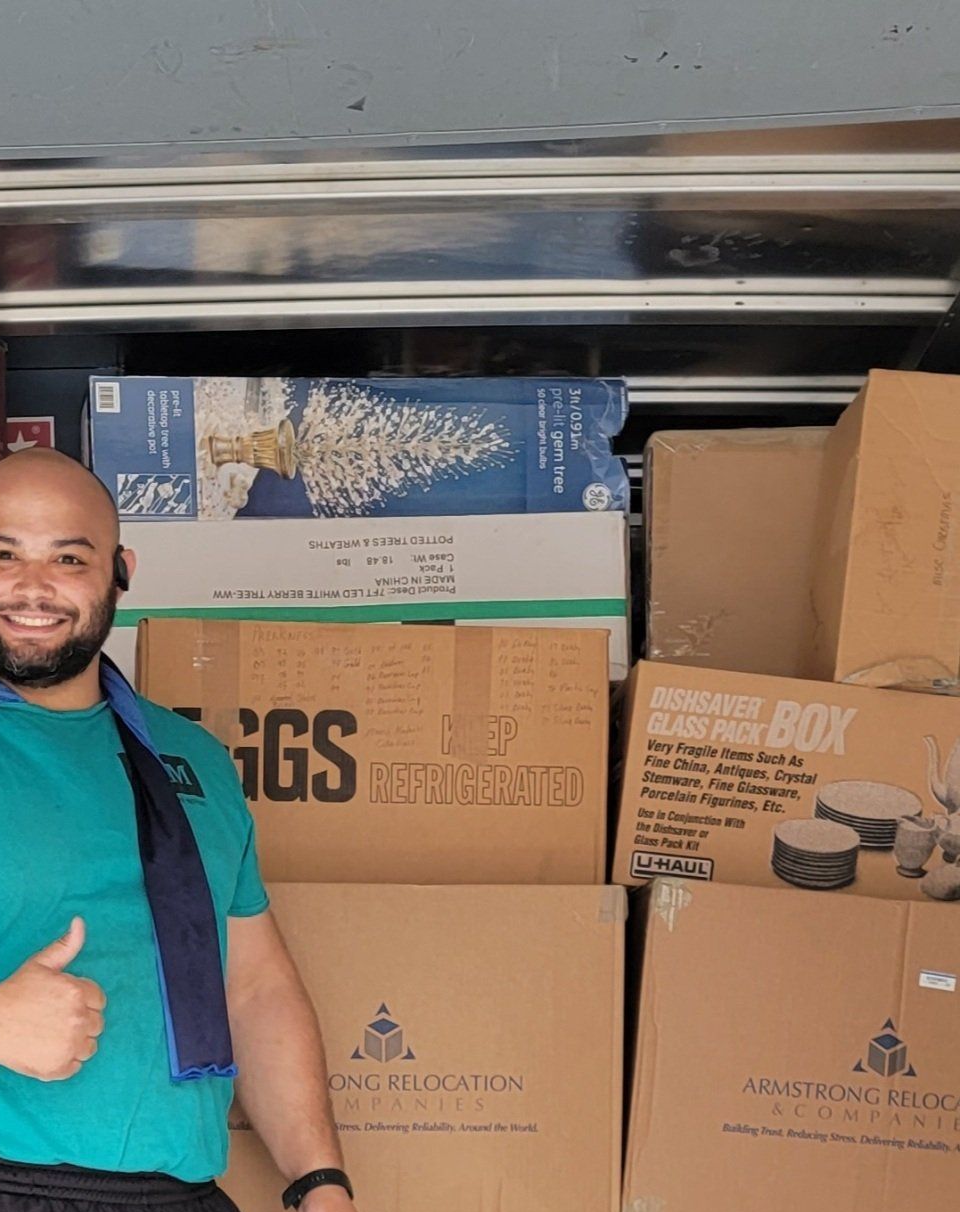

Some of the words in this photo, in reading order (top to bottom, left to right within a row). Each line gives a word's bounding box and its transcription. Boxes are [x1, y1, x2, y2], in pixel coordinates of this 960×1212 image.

[537, 388, 546, 398] 50
[159, 390, 169, 428] tabletop
[171, 390, 182, 417] pre-lit
[538, 399, 546, 418] clear
[549, 388, 567, 428] pre-lit
[147, 390, 157, 438] decorative
[160, 429, 170, 448] tree
[537, 421, 547, 445] bright
[147, 439, 157, 455] pot
[550, 430, 564, 462] gem
[162, 450, 171, 468] with
[539, 446, 547, 470] bulbs
[553, 466, 566, 494] tree
[308, 539, 361, 549] WREATHS
[363, 539, 371, 548] &
[372, 537, 408, 547] TREES
[410, 536, 453, 545] POTTED
[336, 558, 351, 567] lbs
[366, 556, 393, 566] 18.48
[428, 553, 454, 562] Case
[419, 564, 444, 573] Pack
[375, 576, 409, 586] CHINA
[410, 576, 423, 585] IN
[424, 575, 455, 584] MADE
[212, 589, 265, 600] TREE-WW
[267, 589, 305, 599] BERRY
[306, 589, 340, 599] WHITE
[343, 588, 364, 598] LED
[365, 586, 385, 597] 7FT
[390, 587, 416, 595] Desc:
[417, 586, 456, 595] Product
[649, 686, 762, 719] DISHSAVER
[442, 714, 518, 756] KEP
[646, 712, 709, 740] GLASS
[709, 721, 764, 746] PACK
[766, 700, 858, 755] BOX
[172, 708, 357, 802] GGS
[646, 740, 674, 756] Very
[676, 742, 718, 760] Fragile
[720, 748, 753, 762] Items
[756, 752, 786, 766] Such
[787, 755, 804, 768] As
[644, 756, 671, 770] Fine
[673, 759, 710, 776] China,
[714, 764, 771, 781] Antiques,
[774, 770, 818, 787] Crystal
[369, 762, 584, 807] REFRIGERATED
[642, 771, 704, 791] Stemware,
[708, 779, 735, 793] Fine
[737, 782, 801, 801] Glassware,
[640, 787, 698, 806] Porcelain
[700, 793, 758, 812] Figurines,
[763, 799, 786, 814] Etc.
[637, 808, 654, 820] Use
[657, 810, 666, 820] in
[667, 811, 722, 828] Conjunction
[723, 817, 746, 829] With
[636, 822, 651, 833] the
[653, 824, 696, 837] Dishsaver
[699, 829, 709, 838] or
[634, 835, 658, 847] Glass
[660, 837, 683, 850] Pack
[685, 840, 700, 852] Kit
[636, 854, 709, 873] U-HAUL
[388, 1074, 524, 1092] RELOCATION
[742, 1077, 881, 1106] ARMSTRONG
[344, 1097, 486, 1112] MPANIES
[771, 1102, 785, 1117] &
